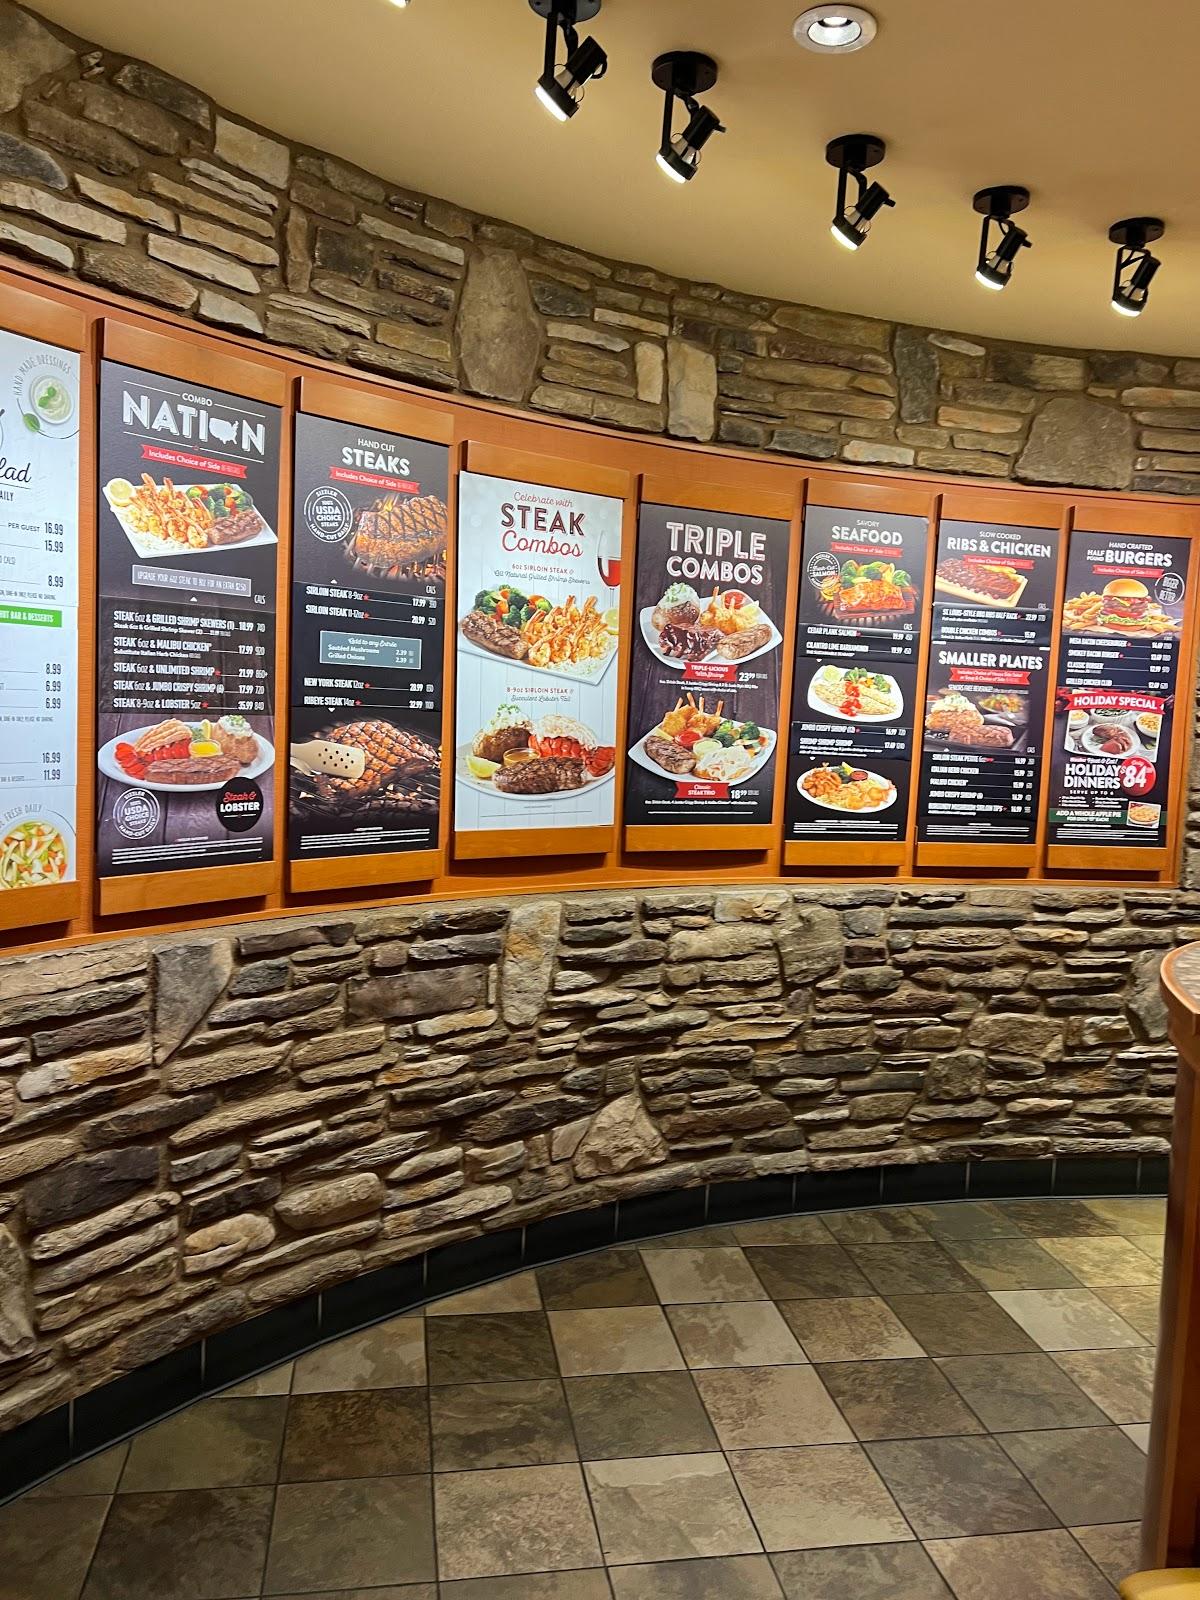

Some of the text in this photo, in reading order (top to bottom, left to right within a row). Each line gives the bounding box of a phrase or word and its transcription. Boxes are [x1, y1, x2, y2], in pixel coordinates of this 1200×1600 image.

[36, 354, 71, 374] DRESSINGS
[182, 393, 213, 407] COMBO
[357, 438, 396, 453] HAND CUT
[149, 450, 175, 461] Includes
[177, 455, 198, 466] Choice
[208, 462, 220, 470] Side
[341, 446, 410, 476] STEAKS
[335, 471, 358, 480] Includes
[359, 475, 378, 484] Choice
[514, 491, 573, 508] Celebrate with
[316, 506, 341, 515] USDA
[501, 502, 585, 537] STEAK
[856, 519, 880, 527] SAVORY
[21, 524, 40, 532] GUEST
[44, 522, 64, 536] 16.99
[831, 525, 903, 546] SEAFOOD
[502, 529, 583, 557] Combos
[666, 521, 767, 561] TRIPLE
[996, 532, 1022, 541] COOKED
[44, 540, 64, 553] 15.99
[947, 536, 1051, 558] RIBS & CHICKEN
[1108, 541, 1153, 551] HAND CRAFTED
[1087, 549, 1173, 567] HALF BURGERS
[524, 564, 548, 572] SIRLOIN
[666, 555, 763, 586] COMBOS
[48, 575, 64, 588] 8.99
[137, 571, 156, 581] UPGRADE
[158, 573, 168, 582] YOUR
[179, 576, 191, 585] STEAK
[192, 577, 198, 585] TO
[223, 581, 235, 590] EXTRA
[412, 598, 426, 607] 17.99
[146, 614, 151, 623] &
[152, 614, 176, 625] GRILLED
[177, 616, 199, 627] SHRIMP
[200, 618, 227, 629] SKEWERS
[150, 639, 156, 648] &
[156, 639, 181, 650] MALIBU
[238, 645, 253, 655] 17.99
[938, 650, 1043, 670] SMALLER PLATES
[46, 664, 61, 675] 8.99
[149, 664, 155, 674] &
[155, 664, 190, 675] UNLIMITED
[191, 666, 215, 676] SHRIMP
[238, 669, 253, 678] 21.99
[45, 681, 61, 692] 6.99
[146, 681, 151, 691] &
[173, 682, 194, 692] CRISPY
[194, 683, 216, 693] SHRIMP
[238, 685, 253, 694] 17.99
[304, 677, 317, 686] NEW
[318, 678, 333, 688] YORK
[45, 698, 61, 709] 6.99
[155, 699, 160, 708] &
[161, 699, 190, 709] LOBSTER
[1074, 696, 1157, 710] HOLIDAY SPECIAL
[42, 752, 61, 764] 16.99
[44, 769, 61, 781] 11.99
[1065, 763, 1121, 777] HOLIDAY
[1063, 776, 1121, 789] DINNERS
[124, 805, 148, 815] USDA
[220, 801, 260, 813] LOBSTER
[125, 811, 149, 822] CHOICE
